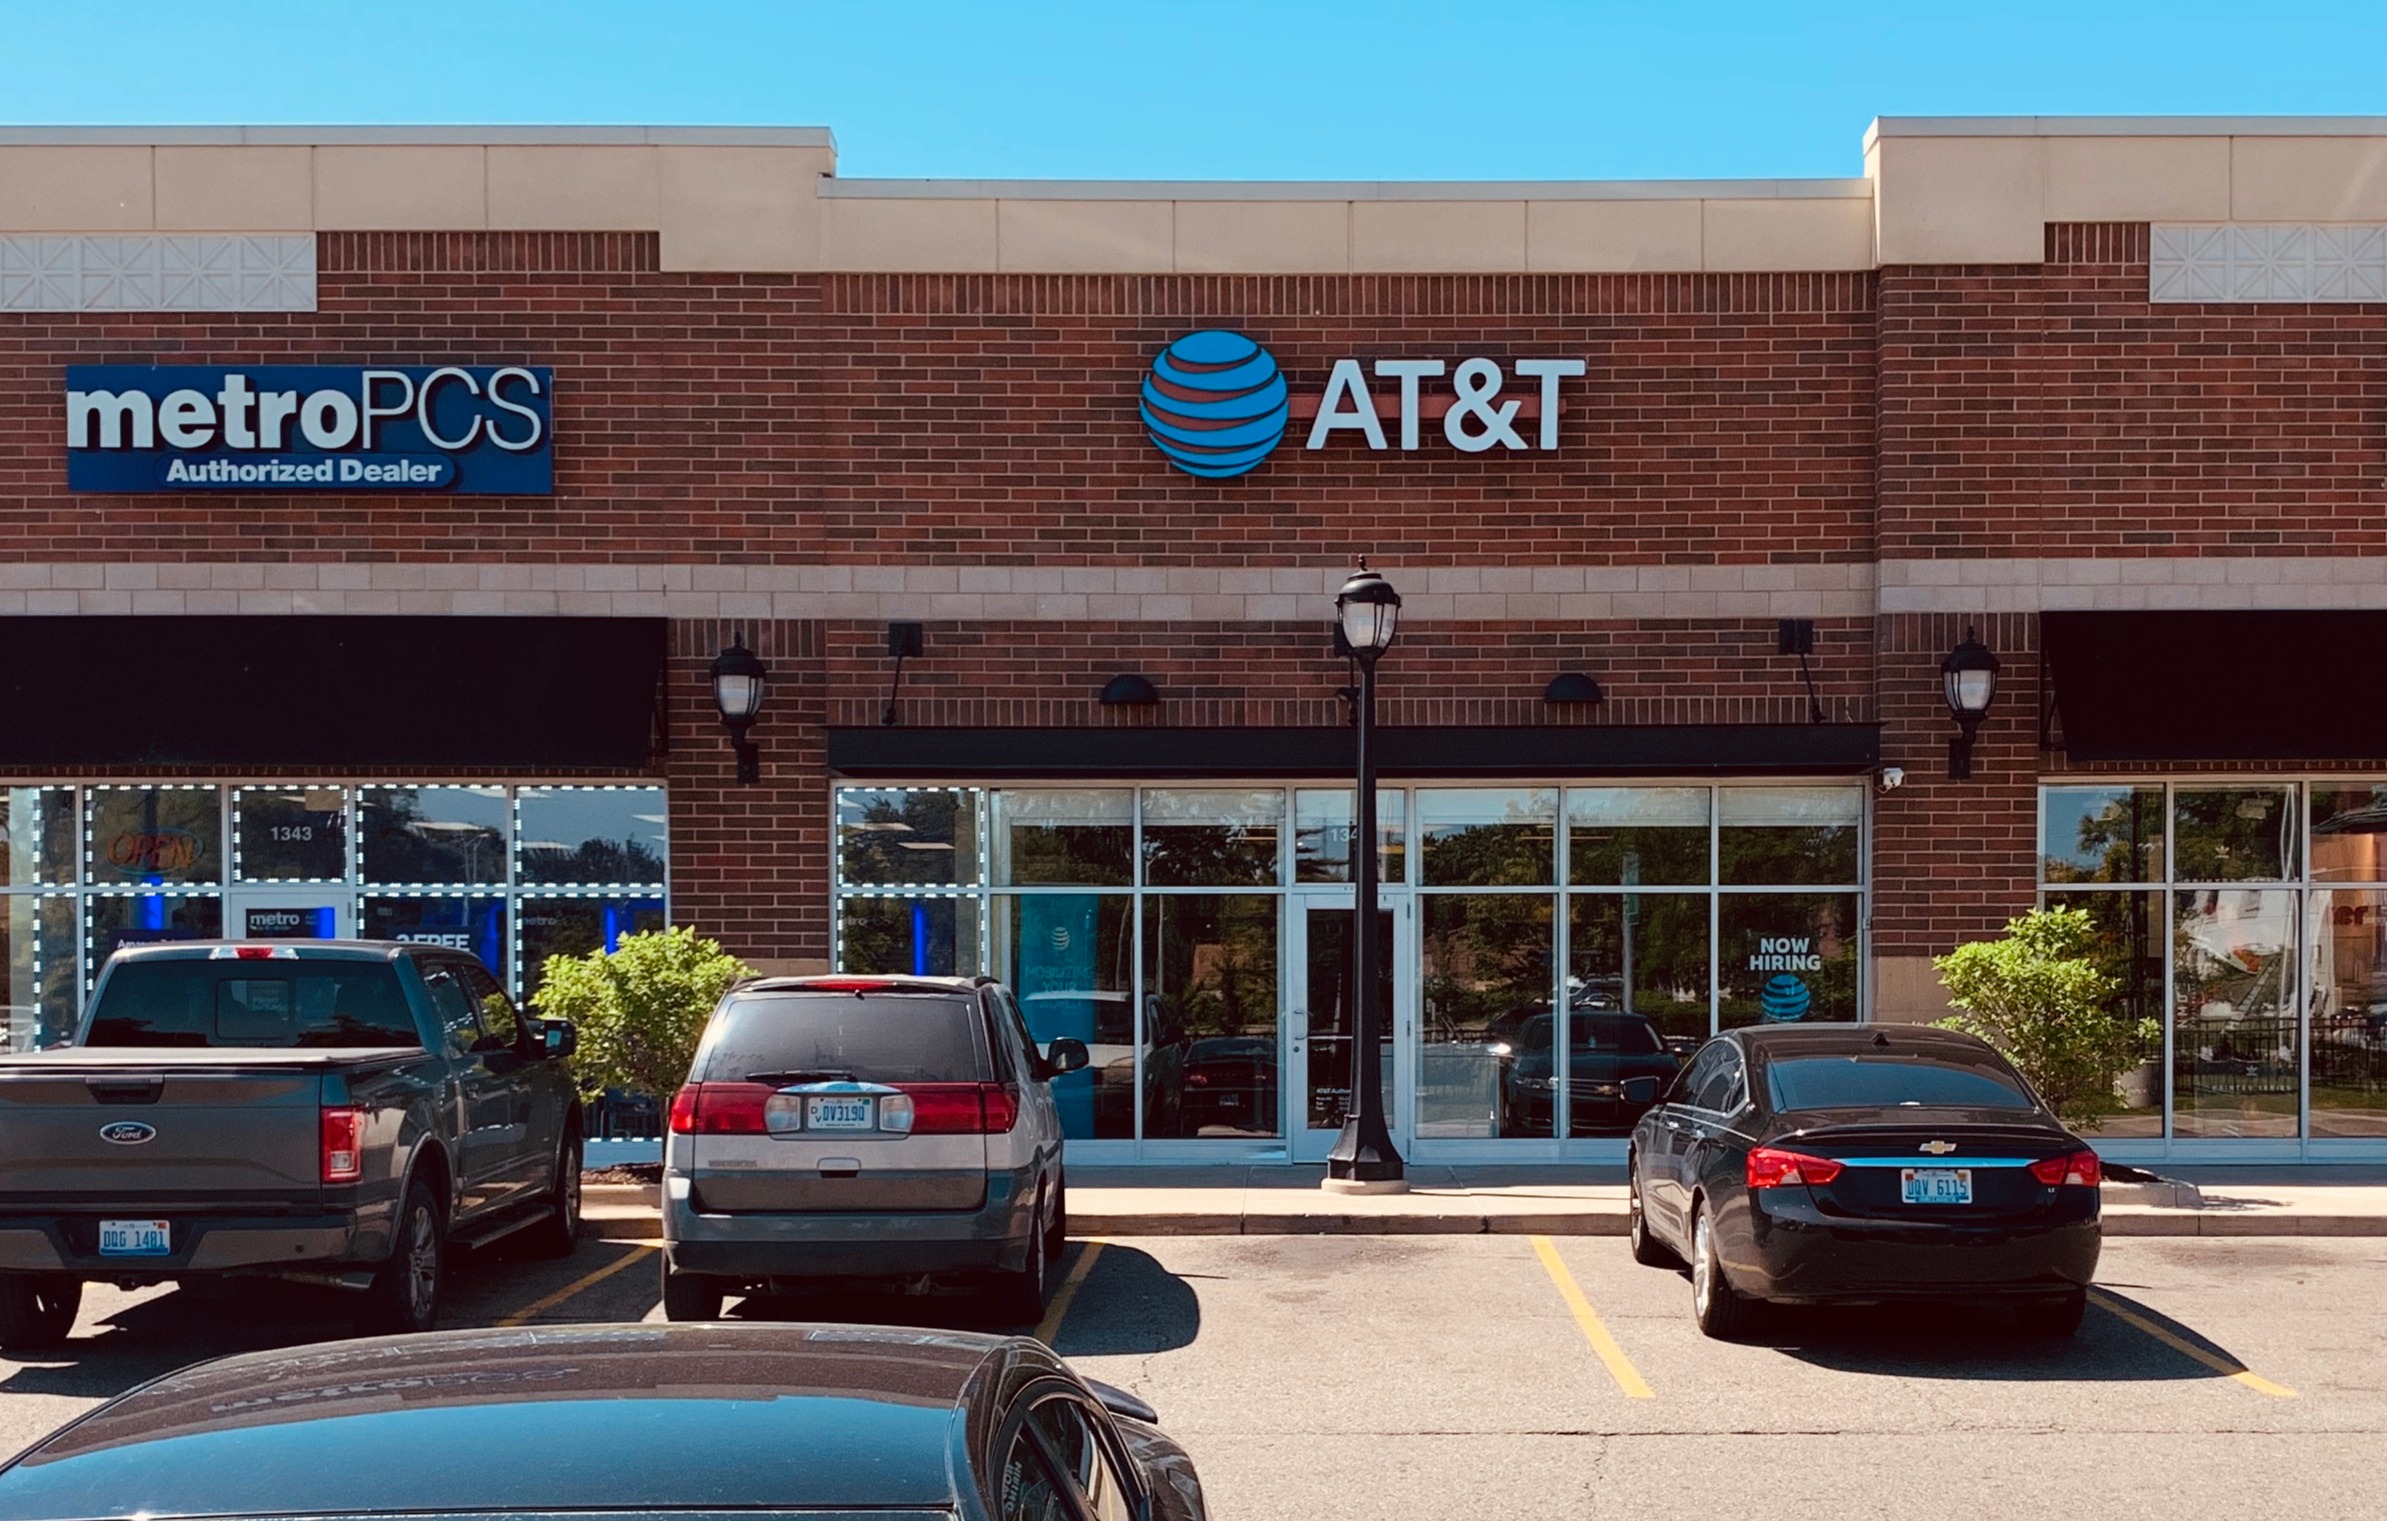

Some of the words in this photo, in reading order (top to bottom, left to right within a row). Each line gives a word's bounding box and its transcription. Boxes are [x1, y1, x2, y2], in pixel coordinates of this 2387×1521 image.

[66, 366, 542, 450] metroPCS
[1306, 357, 1586, 453] AT&T
[166, 458, 333, 483] Authorized
[340, 459, 441, 483] Dealer
[270, 826, 313, 842] 1343
[107, 832, 197, 869] OPEN
[250, 911, 300, 926] metro
[1760, 937, 1810, 954] NOW
[1749, 954, 1821, 971] HIRING
[1024, 965, 1094, 979] MOBILIZING
[1043, 981, 1077, 992] YOUR
[112, 1126, 142, 1139] Ford
[1937, 1179, 1967, 1196] 6115
[135, 1230, 166, 1248] 1481
